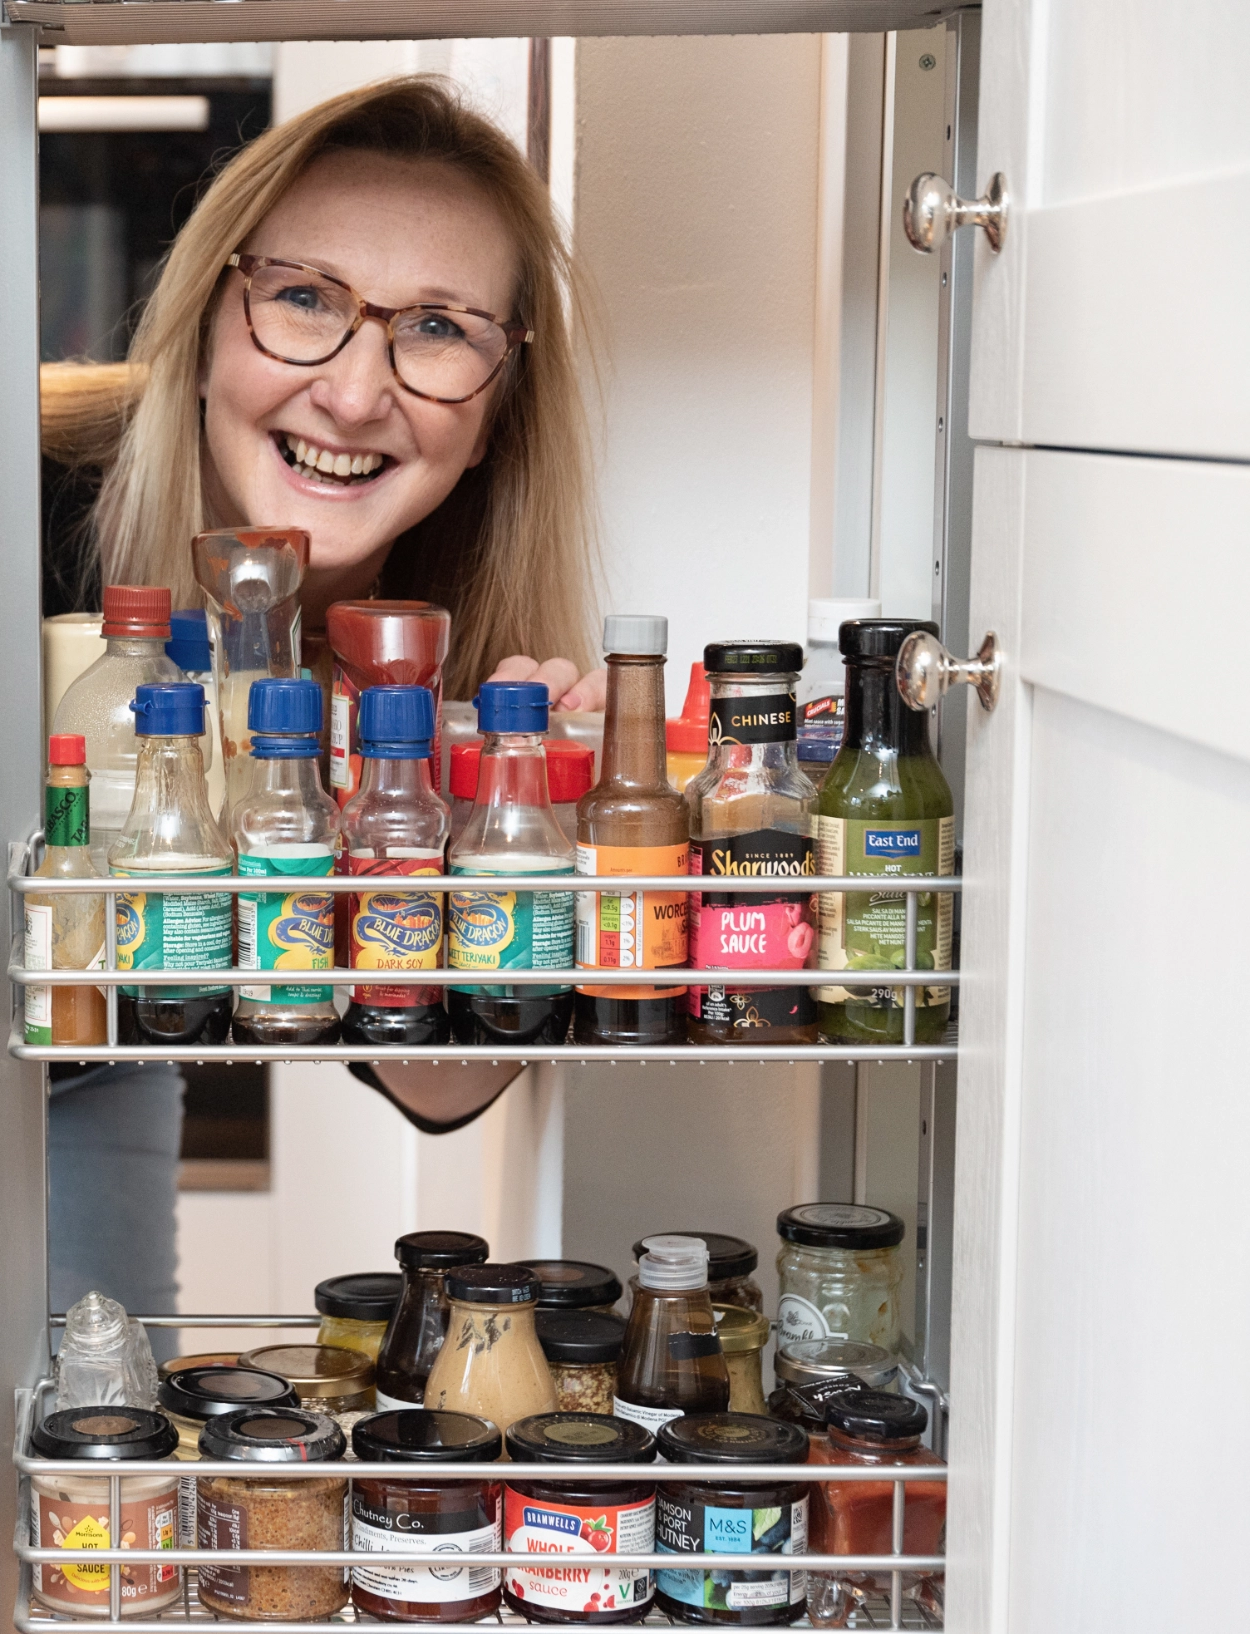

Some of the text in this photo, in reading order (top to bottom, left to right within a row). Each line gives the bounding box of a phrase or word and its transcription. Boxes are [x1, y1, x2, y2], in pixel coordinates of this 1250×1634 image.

[731, 711, 792, 727] CHINESE
[868, 834, 919, 847] East End
[710, 849, 816, 876] Sharwood's
[884, 864, 902, 872] HOT
[603, 904, 618, 912] <0.5g
[466, 917, 507, 942] DRAGON
[603, 922, 618, 930] <0.1g
[721, 911, 766, 932] PLUM
[299, 919, 324, 941] BLUE
[373, 916, 440, 946] BLUE DRAGON
[720, 934, 766, 954] SAUCE
[312, 957, 329, 969] FISH
[377, 958, 424, 969] DARK SOY
[462, 951, 496, 965] TERIYAKI
[871, 988, 897, 1001] 290g
[353, 1499, 425, 1530] Chutney Co.
[526, 1511, 576, 1532] BRAMWELLS
[663, 1513, 687, 1533] PORT
[709, 1518, 747, 1535] M&S
[75, 1530, 103, 1538] Morrisons
[389, 1534, 427, 1545] Preserves.
[657, 1524, 700, 1552] HUTNEY
[76, 1563, 105, 1574] SAUCE
[529, 1580, 568, 1598] sauce
